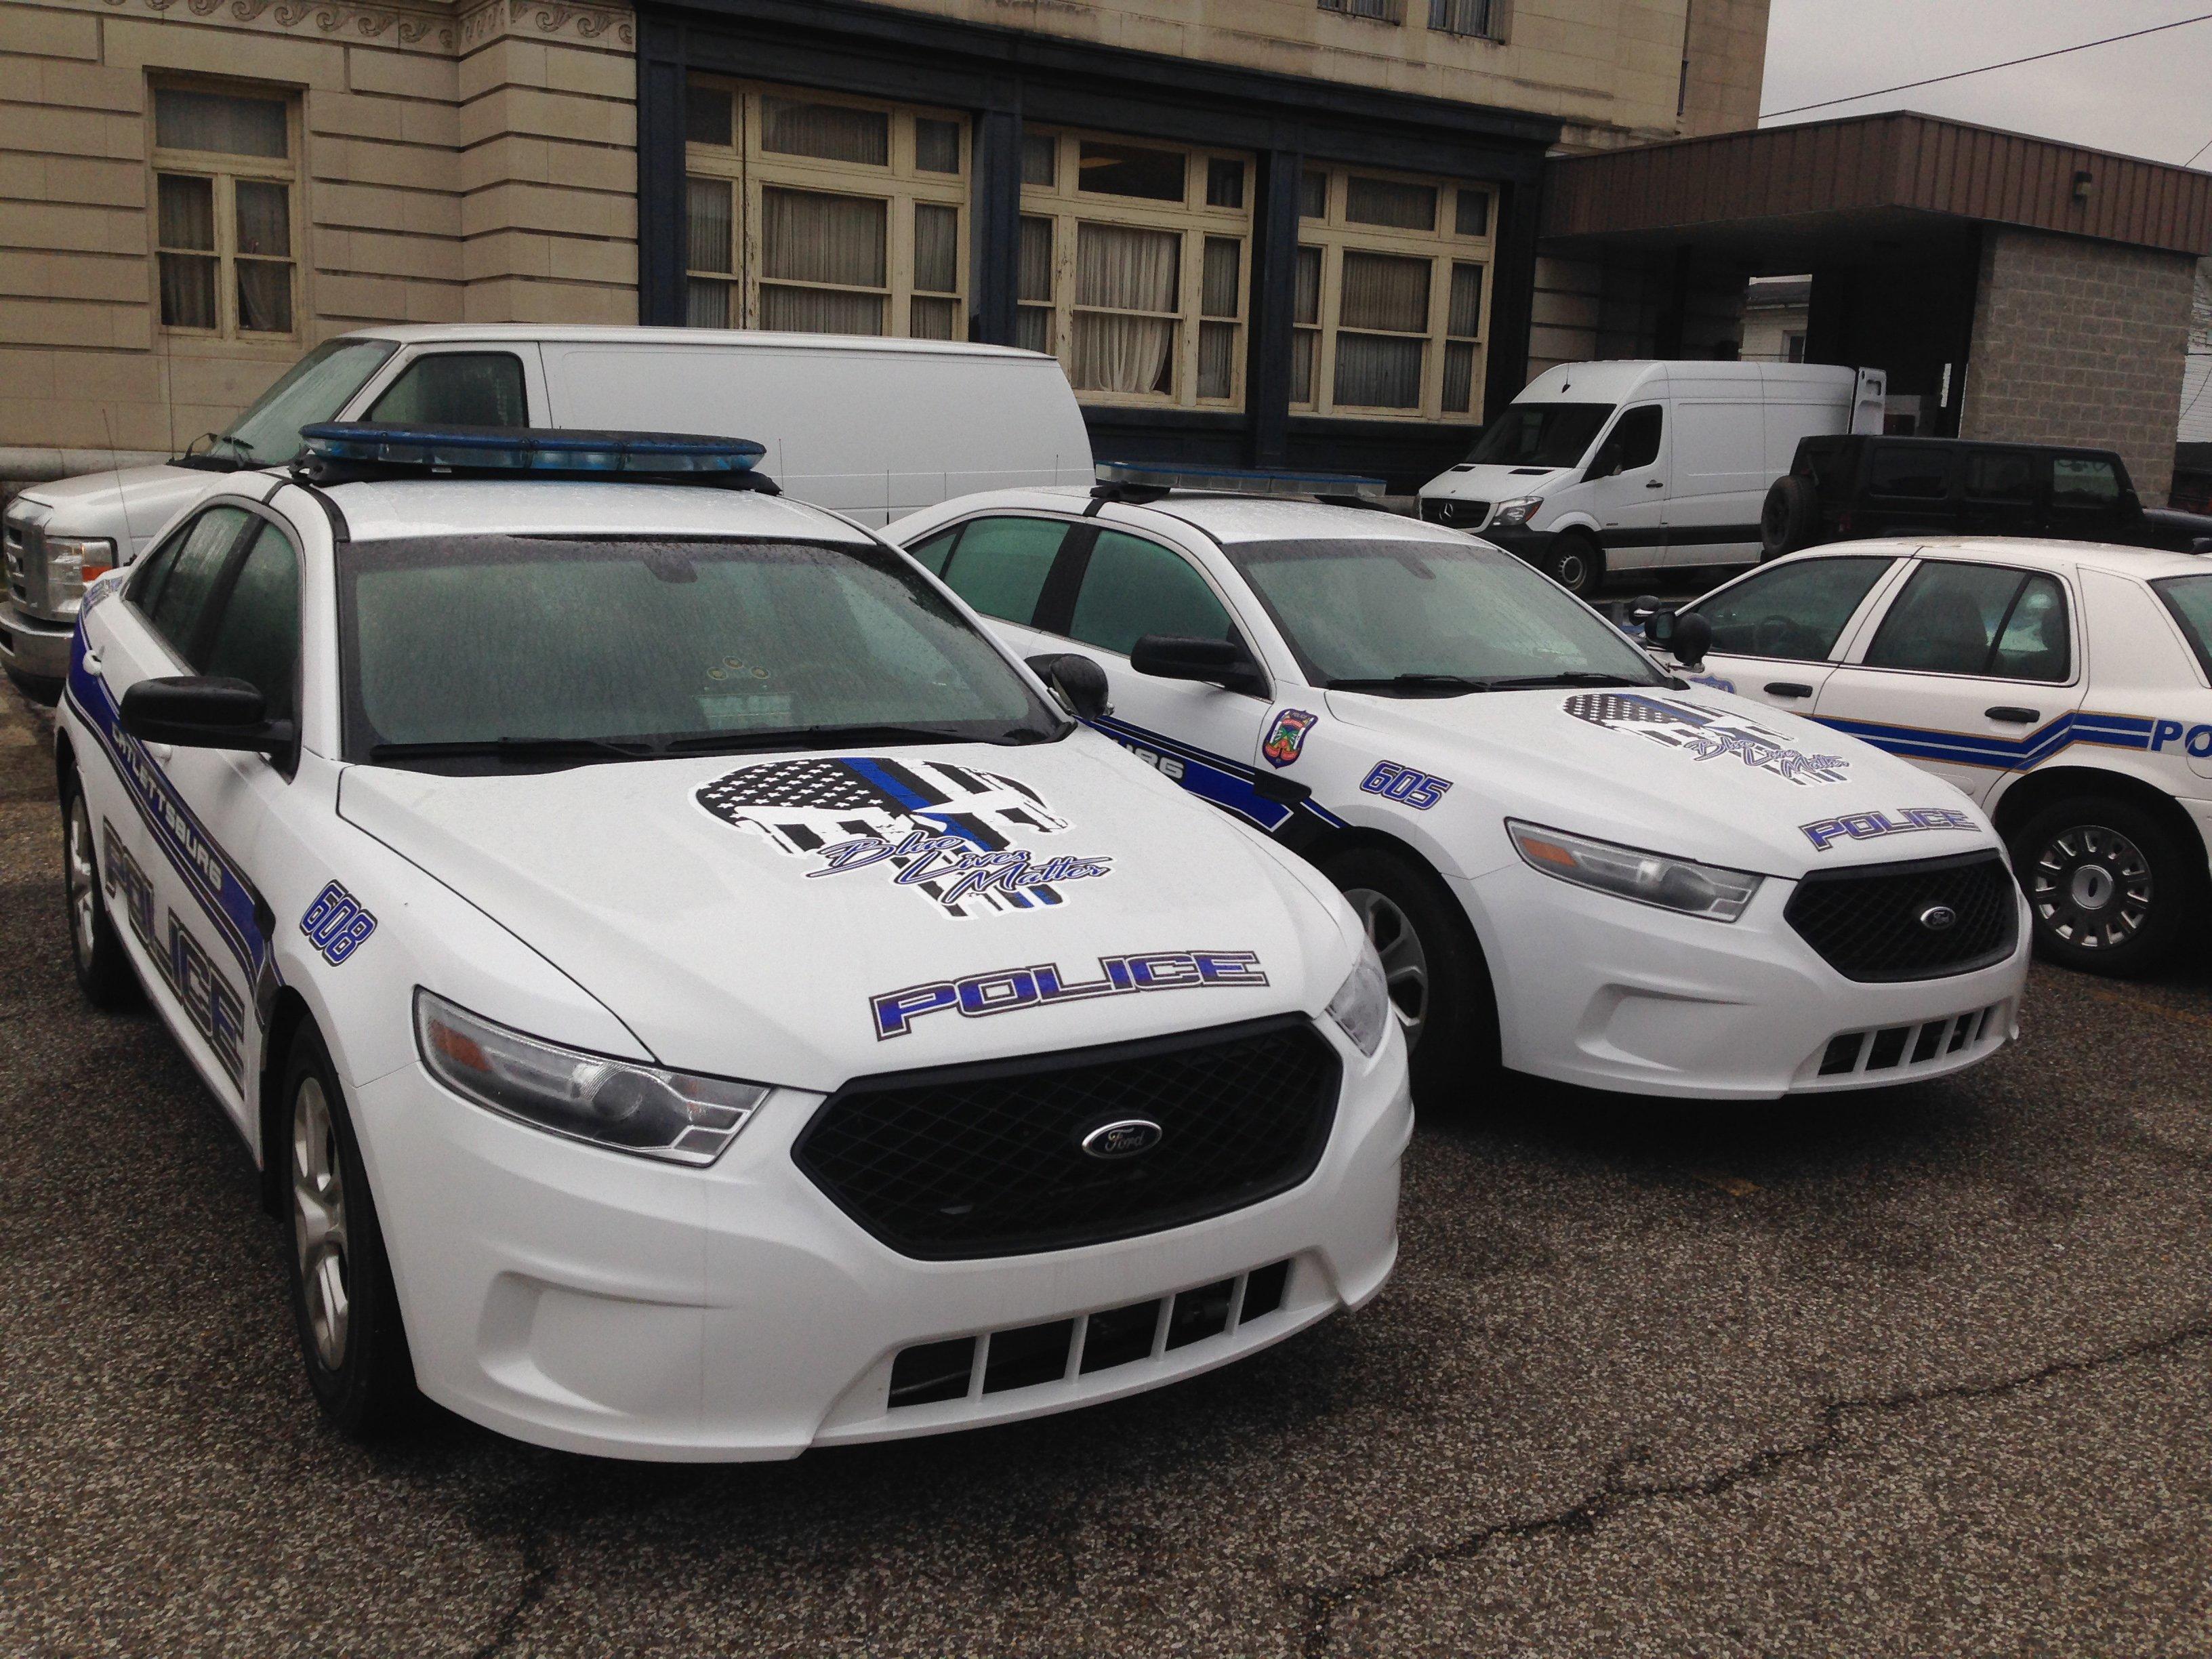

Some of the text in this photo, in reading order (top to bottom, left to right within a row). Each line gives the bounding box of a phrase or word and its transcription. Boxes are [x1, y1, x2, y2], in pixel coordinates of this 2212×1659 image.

[1684, 737, 1755, 761] Blue
[1743, 746, 1800, 766] Lives
[1780, 754, 1849, 778] Matter
[1359, 759, 1454, 811] 605
[806, 830, 964, 878] Blue
[1798, 808, 1982, 852] POLICE
[893, 849, 1031, 884] Lives
[941, 856, 1115, 905] Matter
[300, 879, 378, 967] 608
[103, 815, 245, 1099] POLICE
[869, 950, 1270, 1042] POLICE
